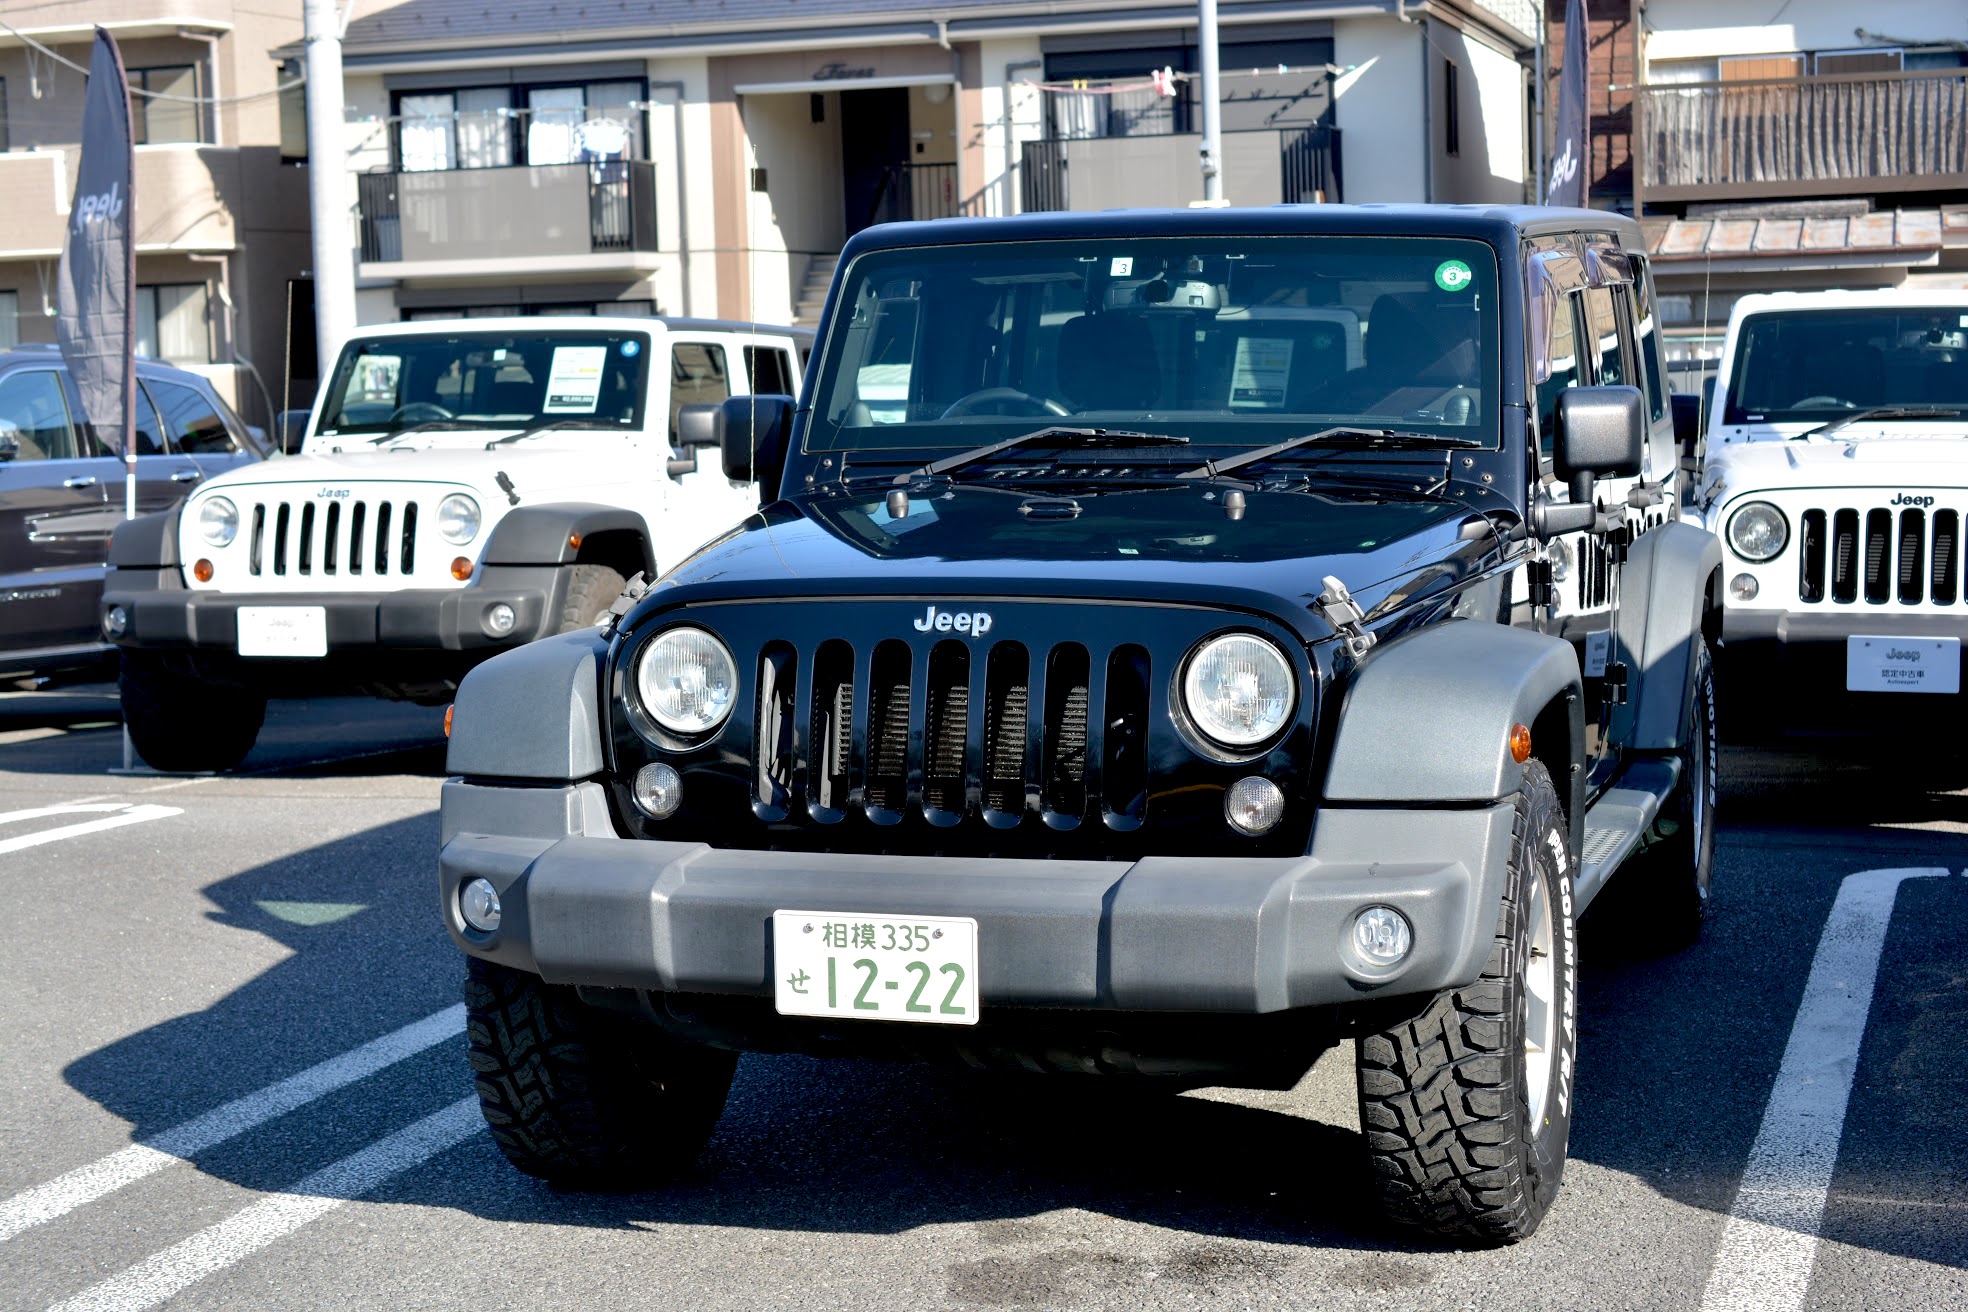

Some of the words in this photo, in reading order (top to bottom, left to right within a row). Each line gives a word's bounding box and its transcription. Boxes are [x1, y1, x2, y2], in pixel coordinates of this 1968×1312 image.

[1120, 264, 1127, 274] 3
[1449, 272, 1457, 281] 3
[317, 487, 350, 500] Jeep
[1890, 492, 1935, 508] Jeep
[913, 606, 992, 638] Jeep
[1886, 648, 1921, 662] Jeep
[1881, 669, 1925, 678] 認定中古車
[1705, 676, 1715, 721] TOYO
[1548, 828, 1567, 875] OPEN
[1560, 877, 1573, 1043] COUNTRY
[787, 968, 811, 994] せ
[827, 956, 966, 1015] 12-22
[1557, 1048, 1571, 1118] R/T
